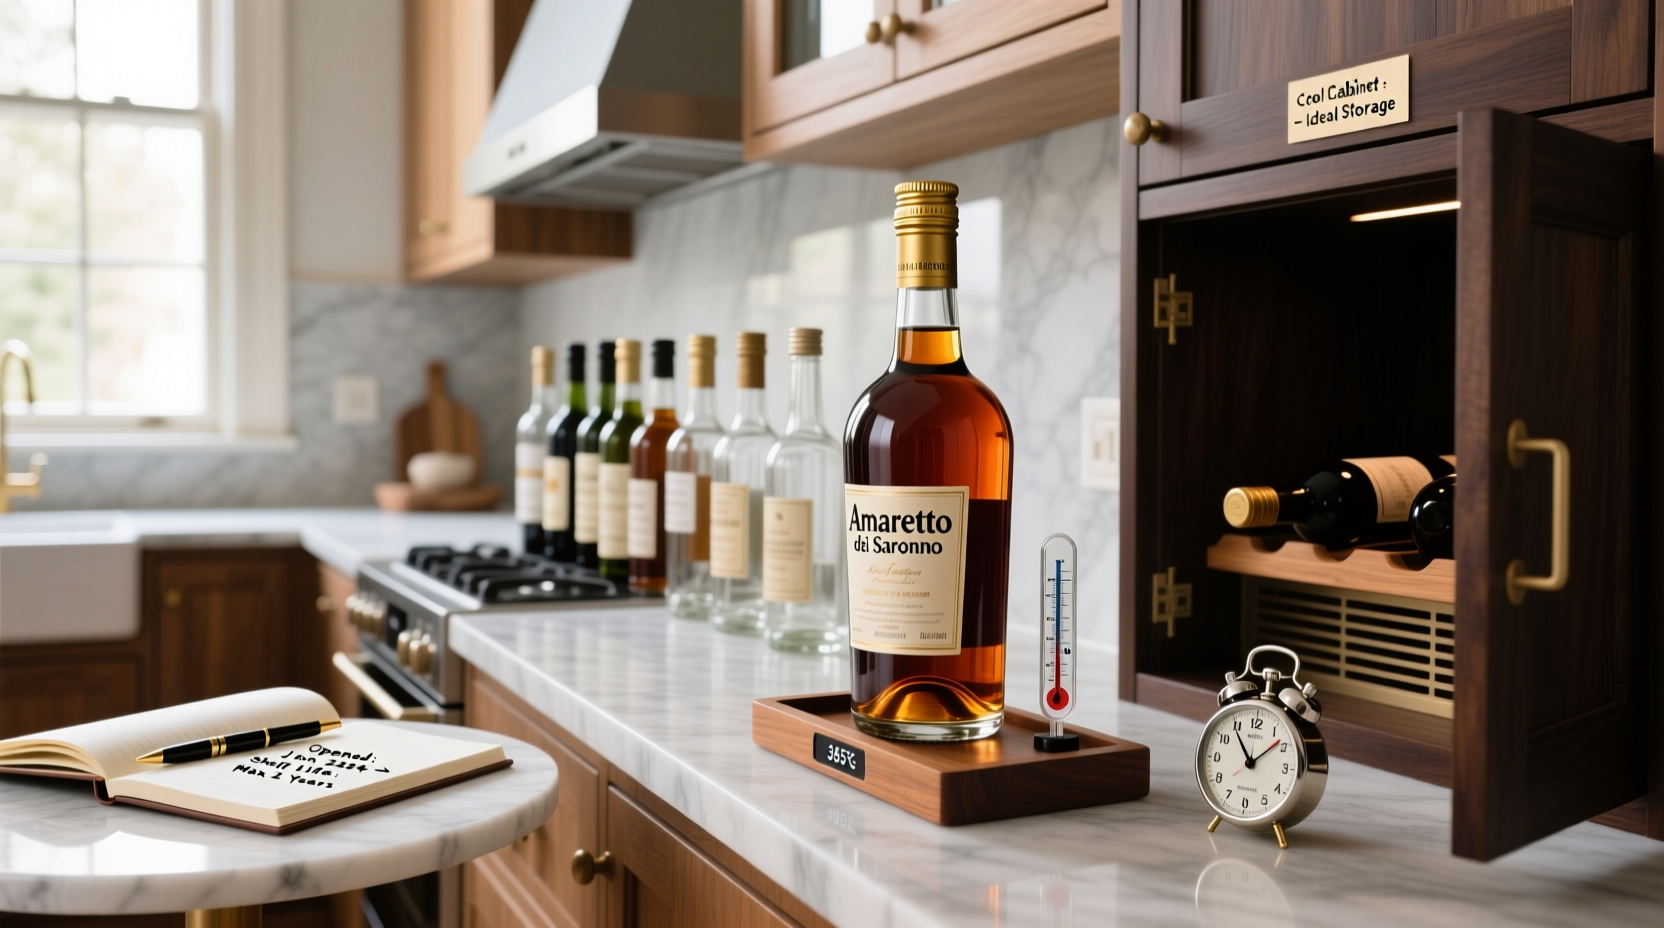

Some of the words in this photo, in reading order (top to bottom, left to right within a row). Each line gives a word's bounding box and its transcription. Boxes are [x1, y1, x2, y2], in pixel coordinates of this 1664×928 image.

[1307, 106, 1338, 127] Ideal
[1342, 99, 1396, 119] Storage
[849, 503, 952, 534] Amaretto
[873, 536, 943, 554] Saronno
[1251, 718, 1263, 730] 12
[1220, 734, 1230, 744] 10
[1226, 790, 1232, 799] 7
